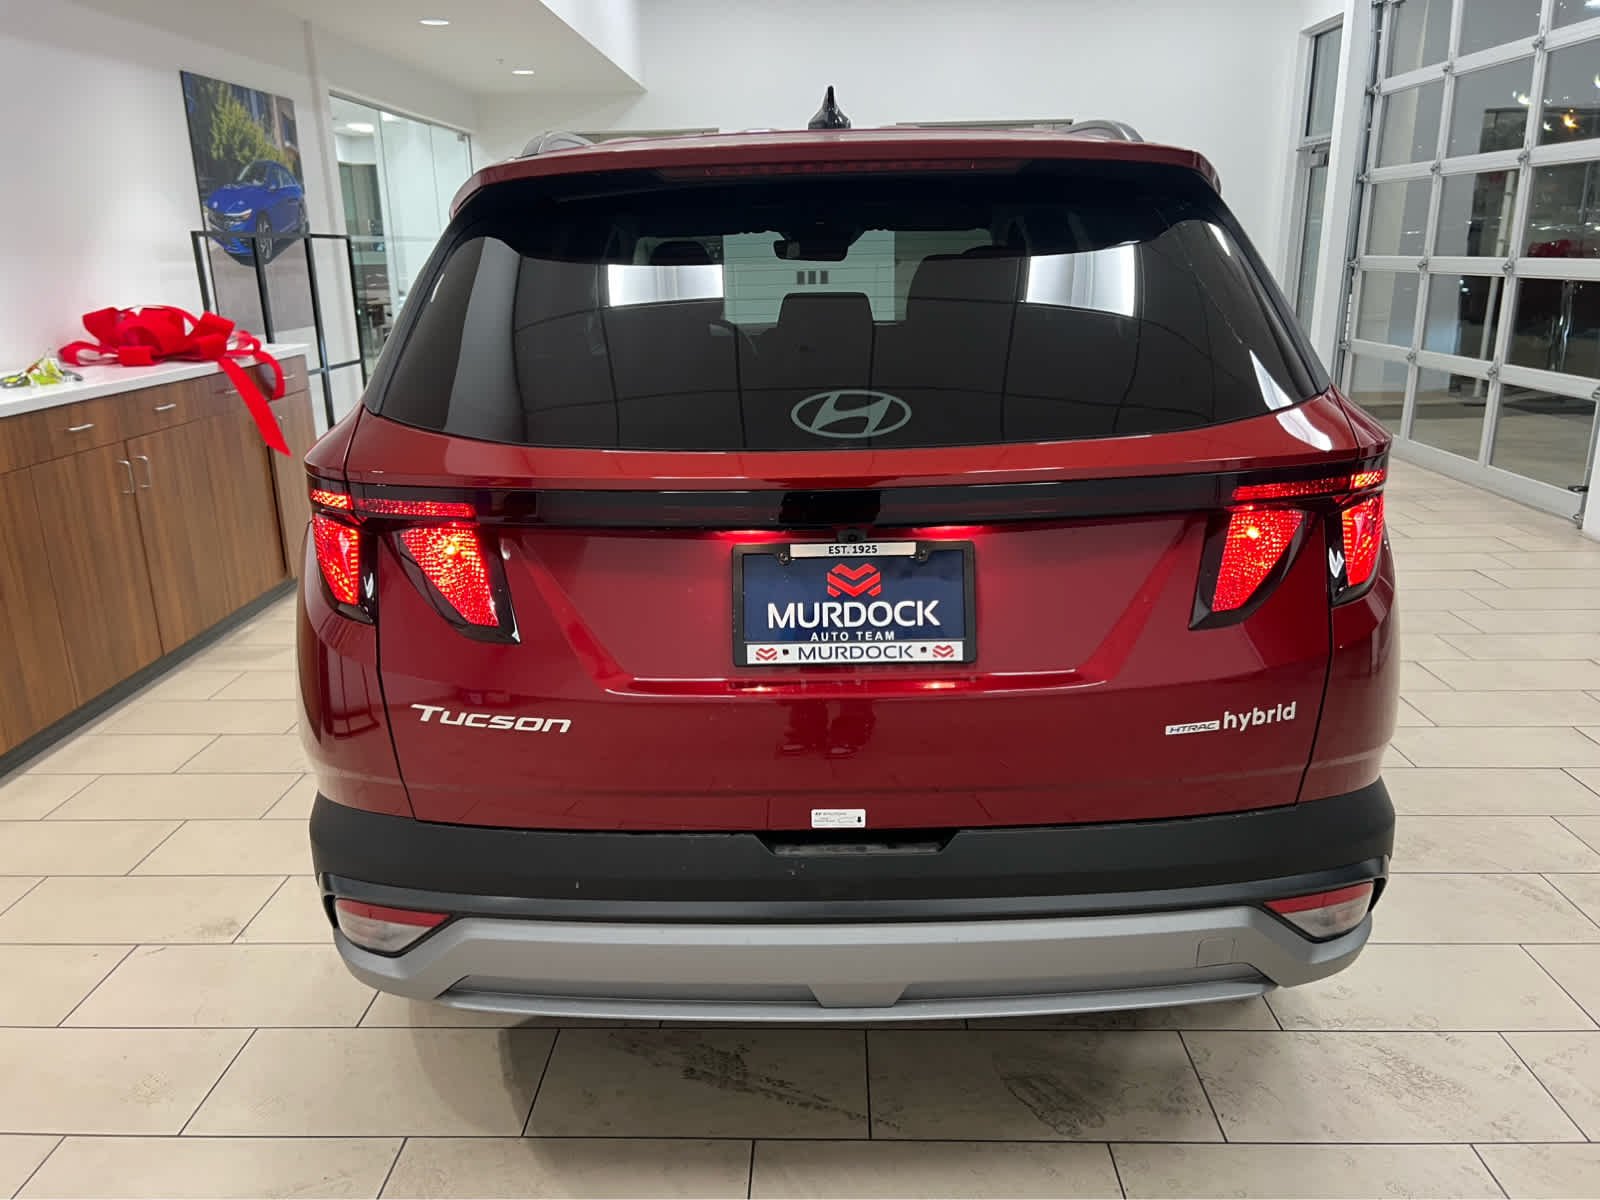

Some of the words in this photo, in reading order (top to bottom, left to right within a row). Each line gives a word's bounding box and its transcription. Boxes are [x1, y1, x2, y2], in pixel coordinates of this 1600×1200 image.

[828, 546, 850, 554] EST.
[852, 545, 878, 554] 1925
[767, 600, 941, 629] MURDOCK
[810, 631, 849, 642] AUTO
[856, 631, 895, 641] TEAM
[798, 645, 914, 660] MURDOCK
[1168, 722, 1217, 733] HTRAC
[1223, 701, 1297, 732] hybrid
